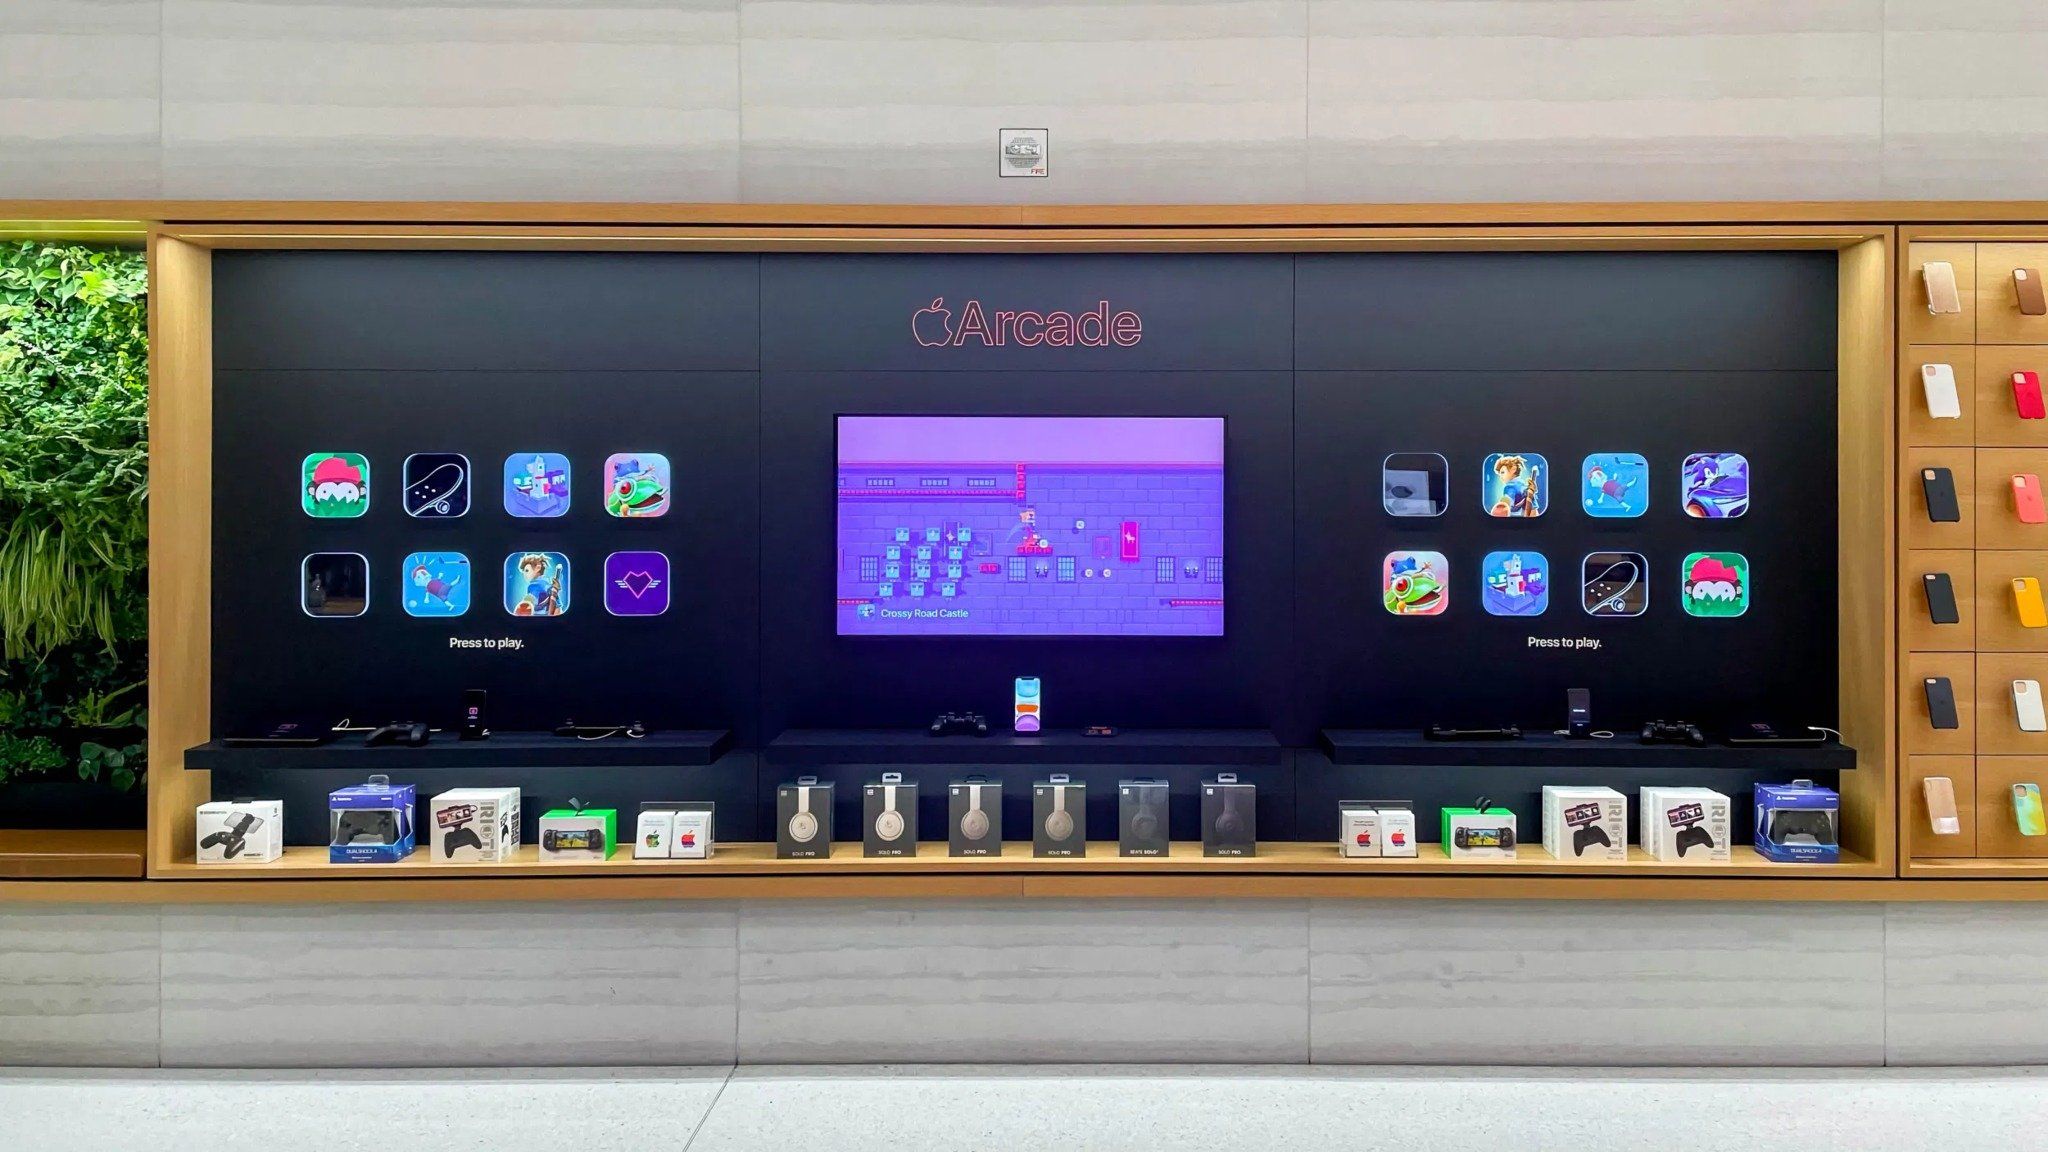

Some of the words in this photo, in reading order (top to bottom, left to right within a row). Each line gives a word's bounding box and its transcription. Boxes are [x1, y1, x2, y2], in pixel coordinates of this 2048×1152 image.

[953, 300, 1142, 347] Arcade
[881, 608, 912, 620] Crossy
[914, 608, 938, 618] Road
[939, 608, 969, 618] Castle
[449, 637, 482, 648] Press
[483, 637, 496, 648] to
[498, 637, 525, 650] play.
[1527, 636, 1560, 647] Press
[1561, 637, 1574, 648] to
[1575, 636, 1602, 650] play.
